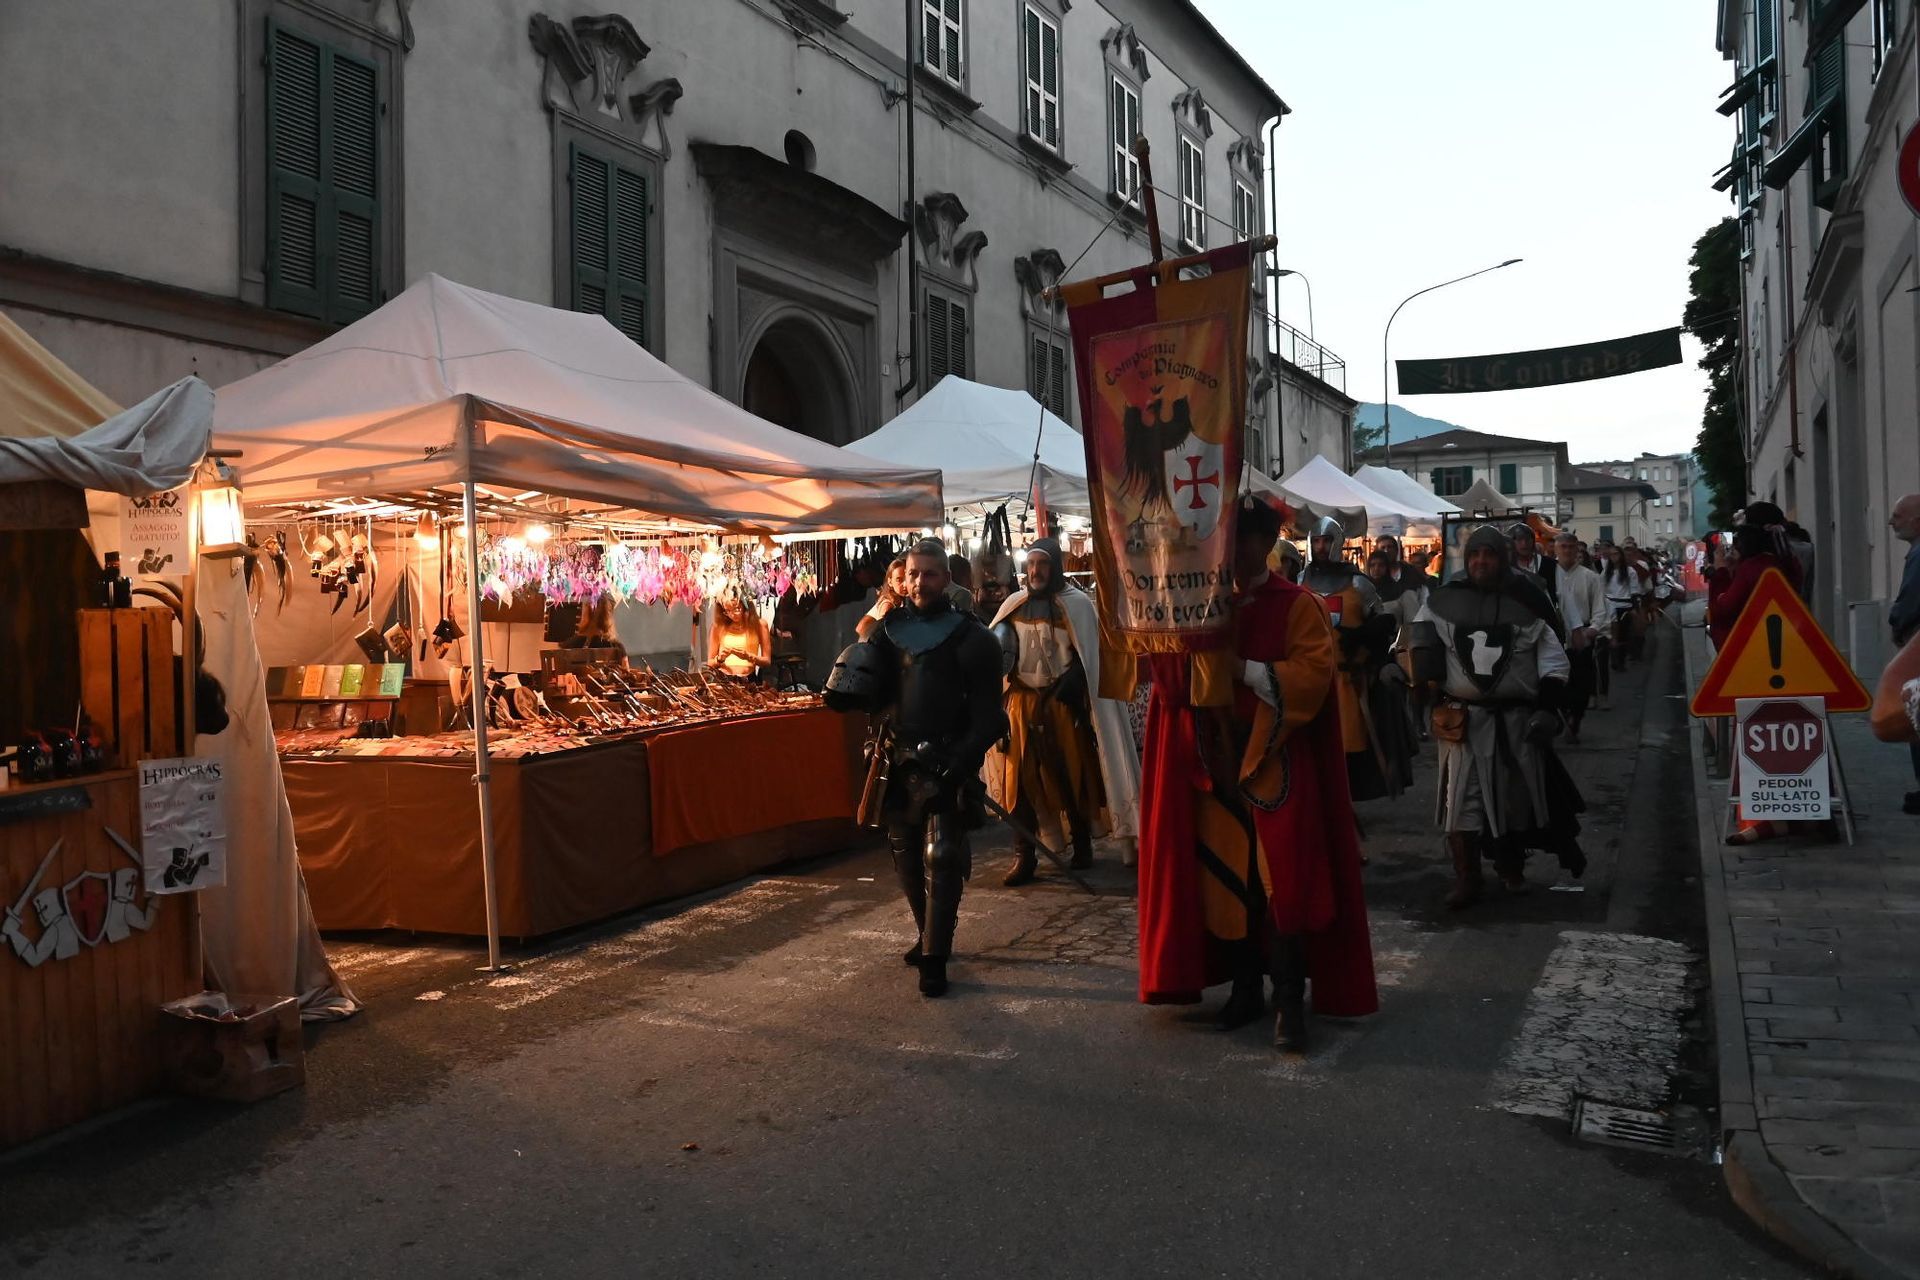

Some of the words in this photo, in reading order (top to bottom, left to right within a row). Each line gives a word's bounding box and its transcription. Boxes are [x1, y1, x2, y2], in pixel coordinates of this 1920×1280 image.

[1748, 723, 1818, 752] STOP
[143, 762, 221, 785] HIPPOCRAS
[1758, 778, 1813, 789] PEDONI
[1783, 790, 1821, 801] LATO
[1751, 802, 1822, 813] OPPOSTO
